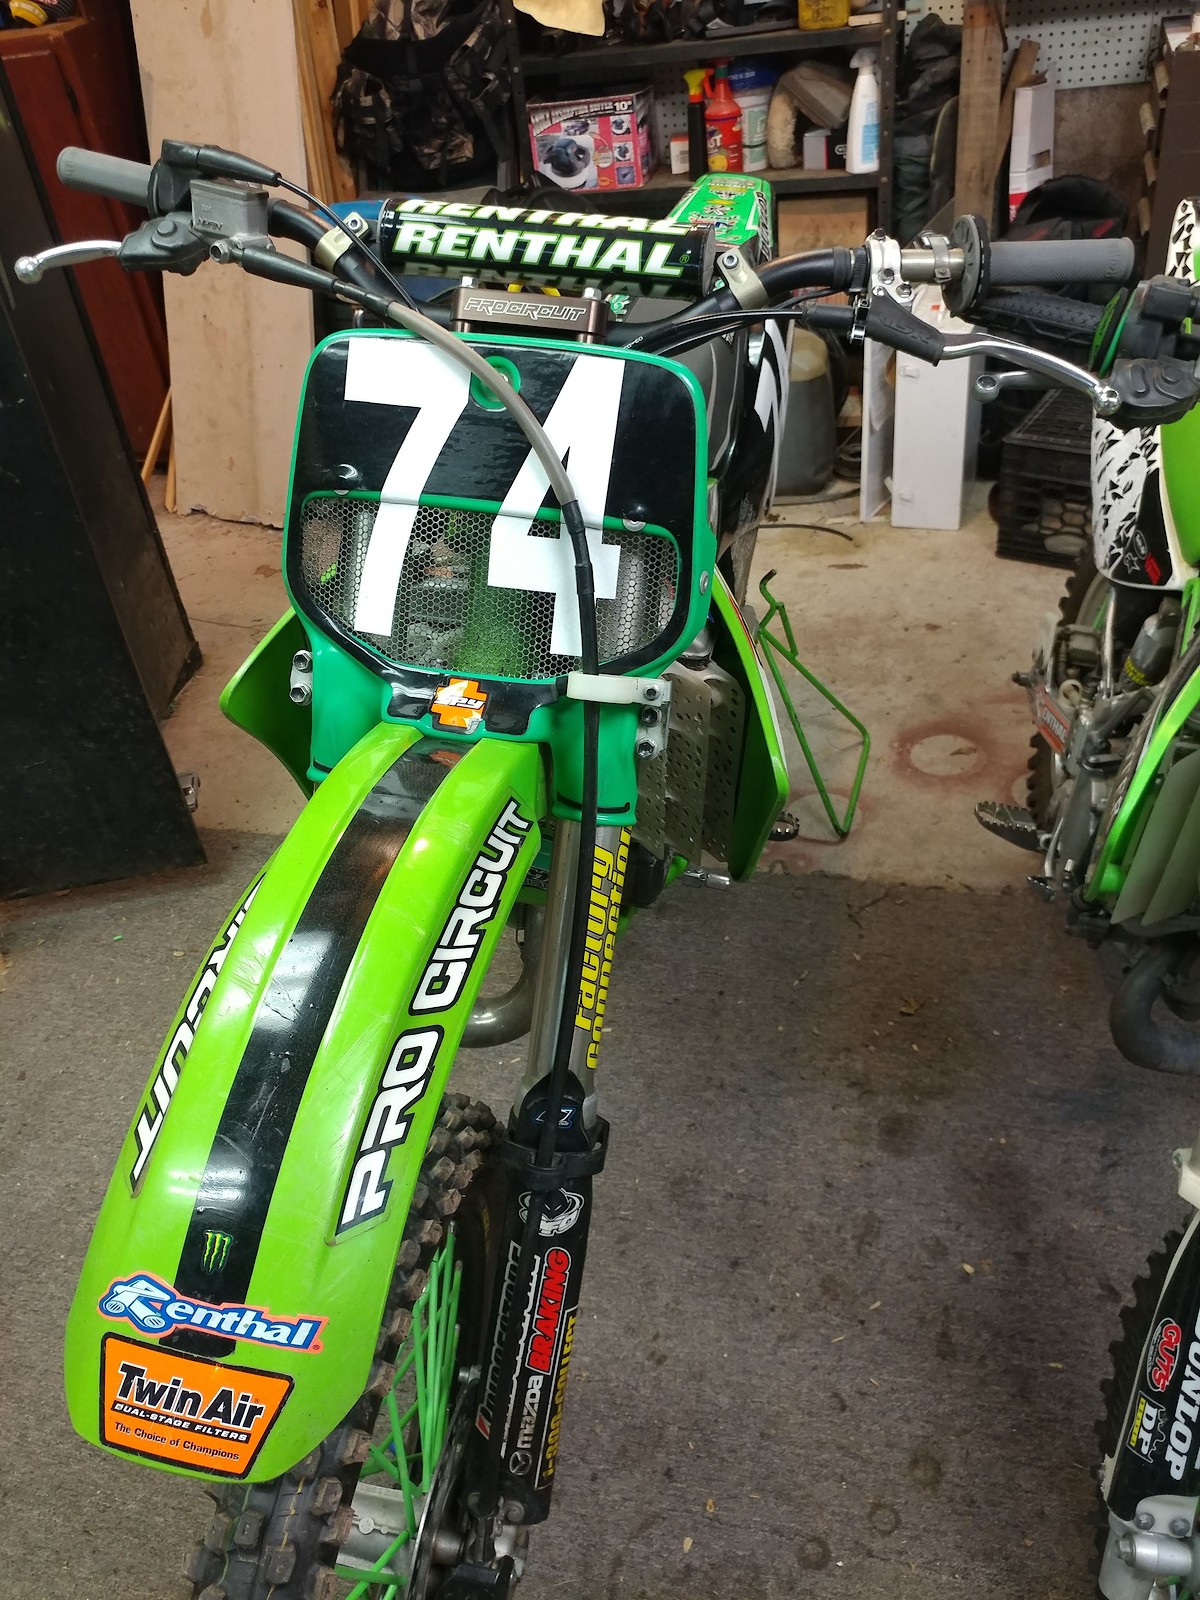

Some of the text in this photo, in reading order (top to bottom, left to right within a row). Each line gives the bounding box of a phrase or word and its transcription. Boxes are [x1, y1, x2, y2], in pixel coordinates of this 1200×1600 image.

[392, 221, 685, 278] RENTHAL
[344, 337, 626, 658] 74
[338, 798, 534, 1234] PRO CIRCUIT
[101, 1279, 314, 1348] Renthal
[527, 1248, 571, 1373] BRAKING
[1151, 1323, 1182, 1392] GUTS
[113, 1403, 249, 1442] DUAL-STAGE FILTERS
[116, 1361, 266, 1431] Twin Air
[1138, 1402, 1158, 1456] DP
[115, 1422, 240, 1461] The Choice of Champions
